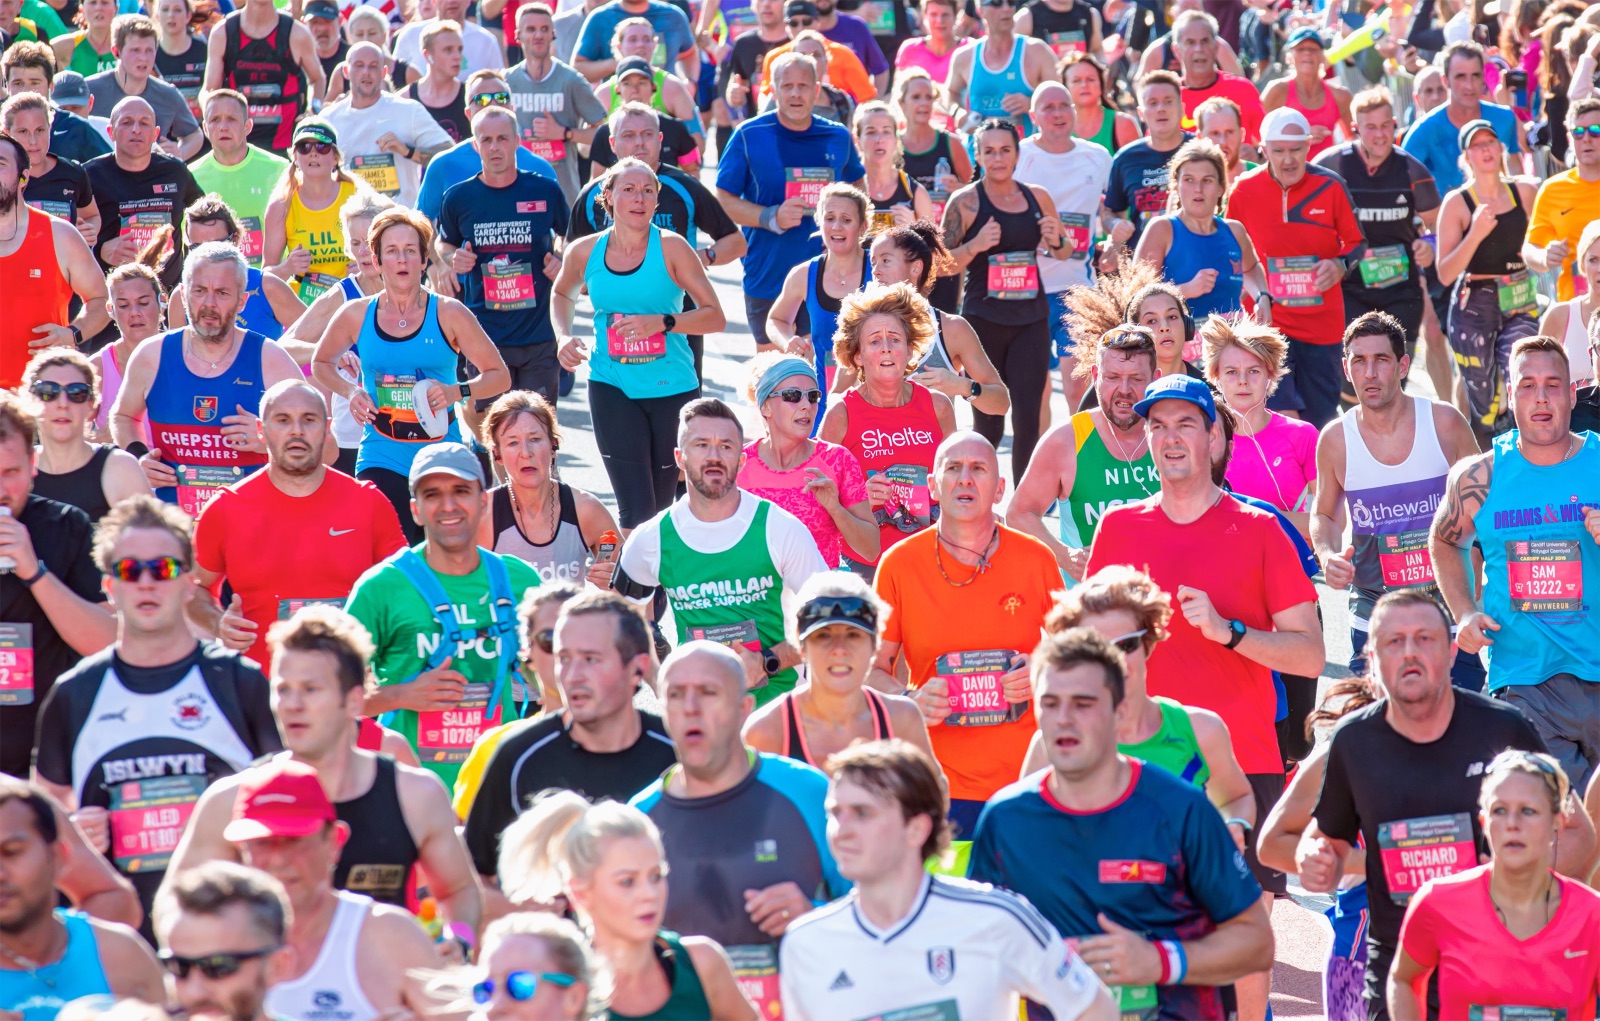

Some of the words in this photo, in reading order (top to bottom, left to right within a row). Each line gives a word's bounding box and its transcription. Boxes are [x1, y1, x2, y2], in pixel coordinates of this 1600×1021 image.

[511, 92, 565, 112] PUMA
[1359, 207, 1409, 221] ATTHEW
[474, 222, 497, 230] CARDIFF
[474, 227, 508, 237] CARDIFF
[509, 226, 531, 235] HALF
[310, 231, 338, 246] LIL
[475, 234, 532, 247] MARATHON
[310, 256, 351, 265] NNERS
[497, 279, 517, 289] GARY
[1280, 273, 1312, 284] PATRICK
[496, 288, 520, 300] 13405
[623, 341, 650, 352] 13411
[861, 427, 934, 449] Shelter
[176, 448, 239, 459] HARRIERS
[863, 448, 895, 459] Cymru
[1105, 465, 1160, 486] NICK
[1494, 507, 1542, 530] DREAMS
[1543, 503, 1559, 524] &
[1405, 553, 1423, 566] IAN
[1400, 566, 1434, 582] 12574
[1532, 565, 1556, 578] SAM
[665, 575, 774, 601] MACMILLAN
[1526, 580, 1562, 595] 13222
[713, 590, 768, 607] SUPPORT
[1522, 602, 1569, 611] #WHYWERUN
[416, 632, 502, 660] NPC
[962, 676, 996, 691] DAVID
[961, 691, 999, 708] 13062
[442, 711, 481, 726] SALAH
[102, 753, 206, 784] ISLWYN
[143, 808, 180, 828] ALED
[1400, 846, 1458, 868] RICHARD
